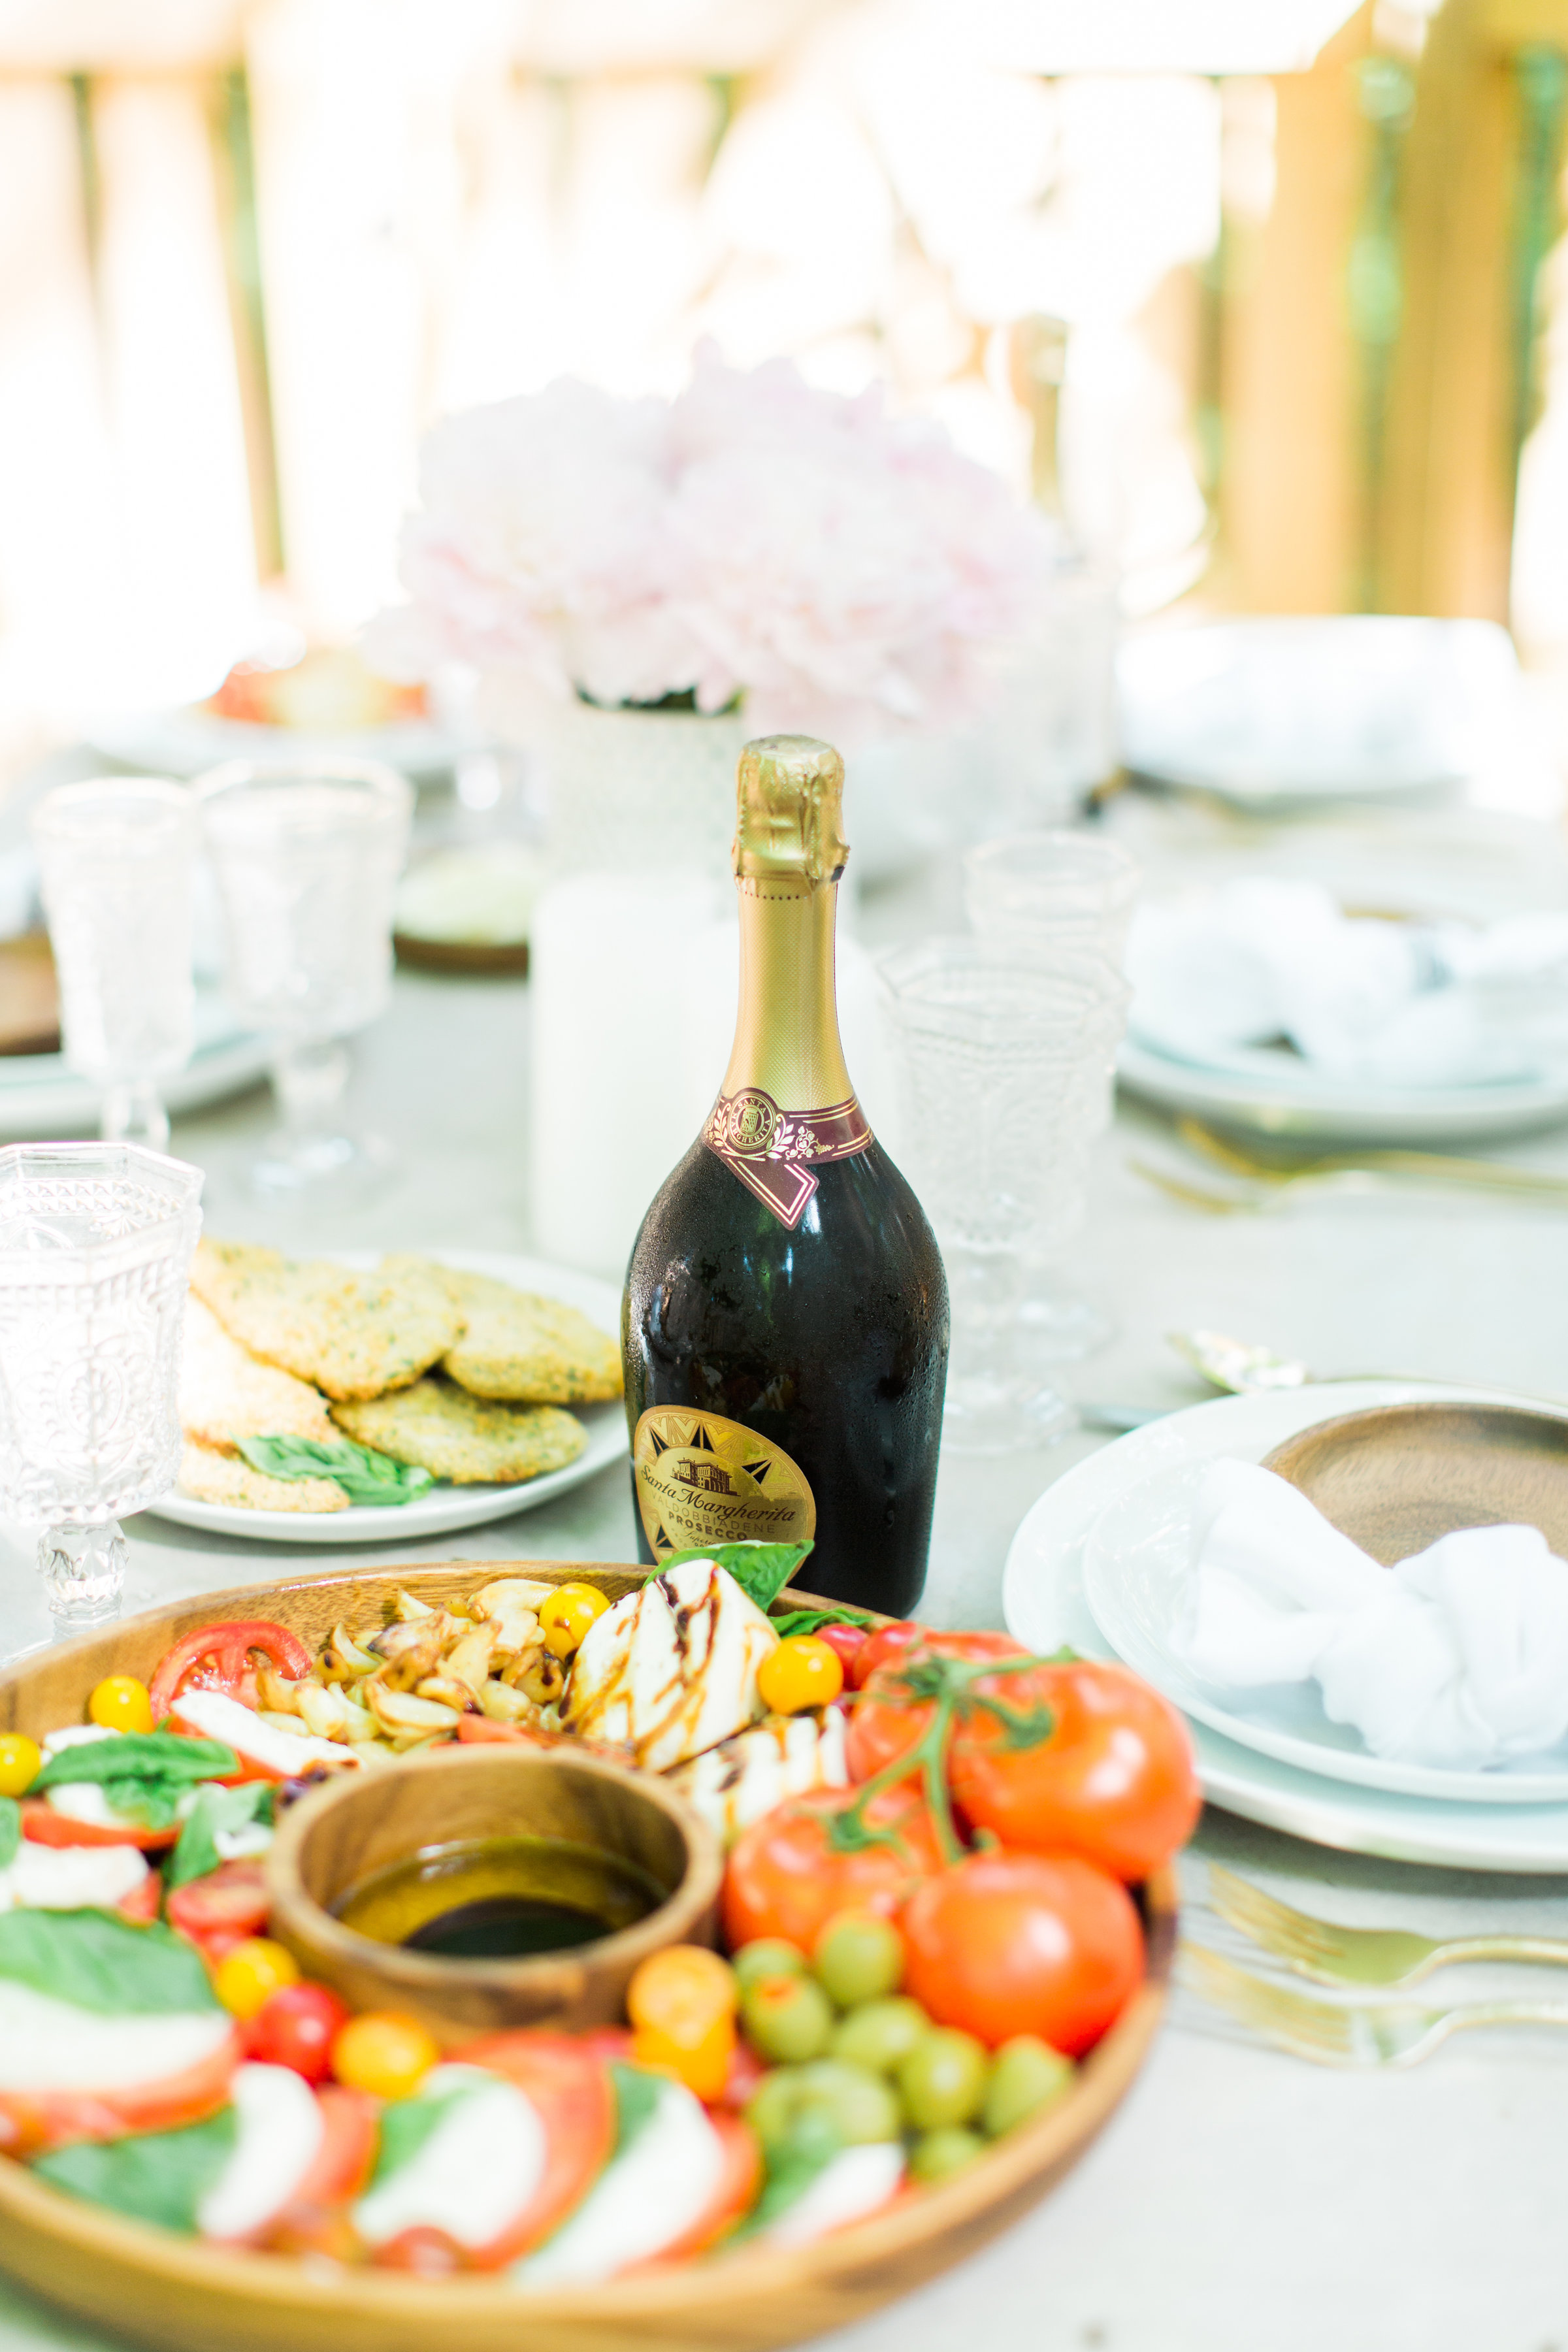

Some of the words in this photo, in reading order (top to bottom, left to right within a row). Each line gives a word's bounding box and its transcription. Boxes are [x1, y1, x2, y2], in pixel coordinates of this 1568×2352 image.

[738, 1098, 766, 1114] SANTA
[731, 1113, 770, 1143] MARGHERITA
[642, 1465, 677, 1499] Santa
[677, 1488, 796, 1521] Margherita
[651, 1490, 775, 1534] VALDOBBIADENE
[668, 1511, 747, 1541] PROSECCO
